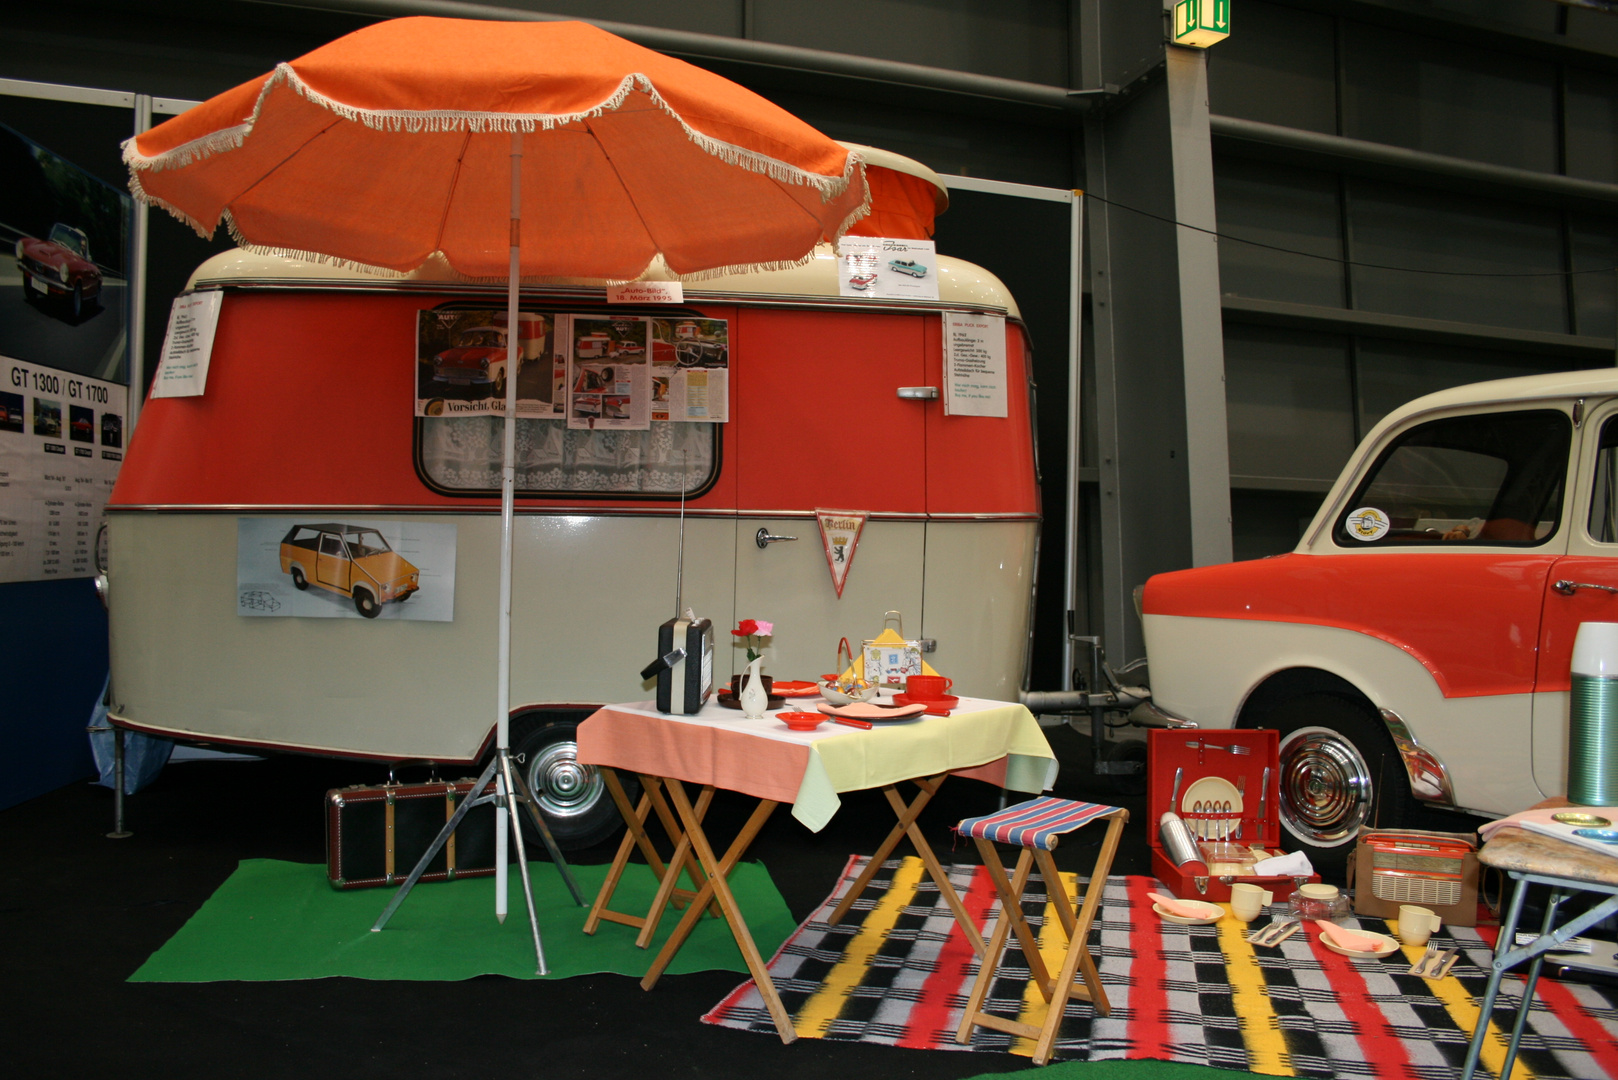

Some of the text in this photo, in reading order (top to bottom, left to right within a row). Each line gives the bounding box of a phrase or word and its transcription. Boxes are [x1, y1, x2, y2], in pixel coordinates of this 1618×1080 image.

[11, 366, 108, 404] GT 1300 / GT 1700
[447, 402, 490, 412] Vorsicht,
[491, 401, 506, 410] Gla
[825, 518, 856, 530] Berlin
